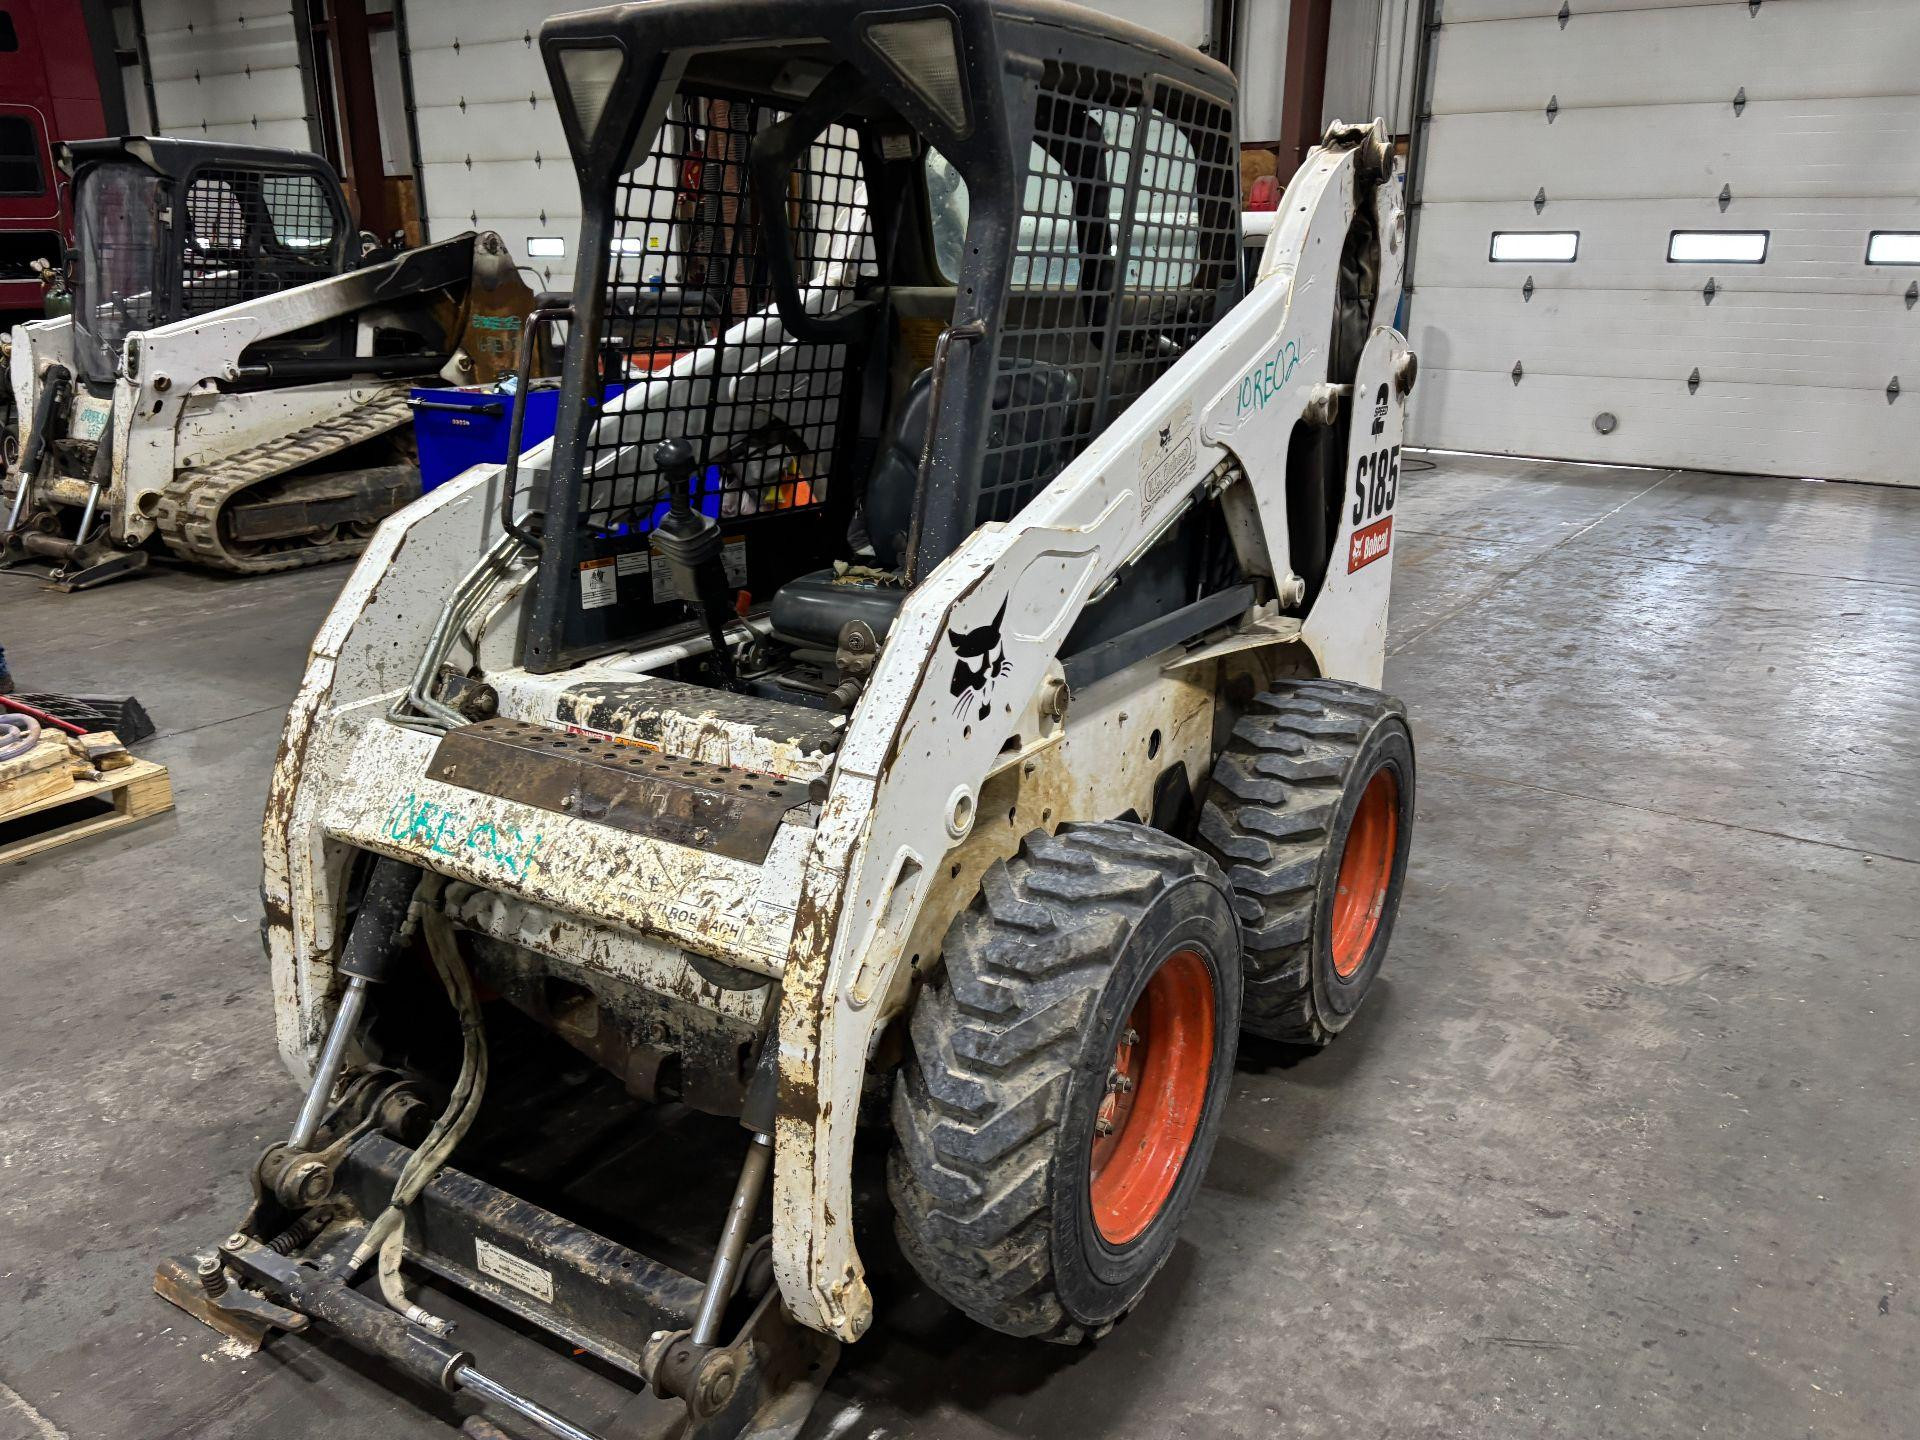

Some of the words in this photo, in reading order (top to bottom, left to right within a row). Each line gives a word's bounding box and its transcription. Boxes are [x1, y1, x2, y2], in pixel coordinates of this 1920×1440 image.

[1236, 337, 1301, 416] 10RE021
[1353, 445, 1400, 526] S185
[1363, 527, 1388, 560] Bobcat
